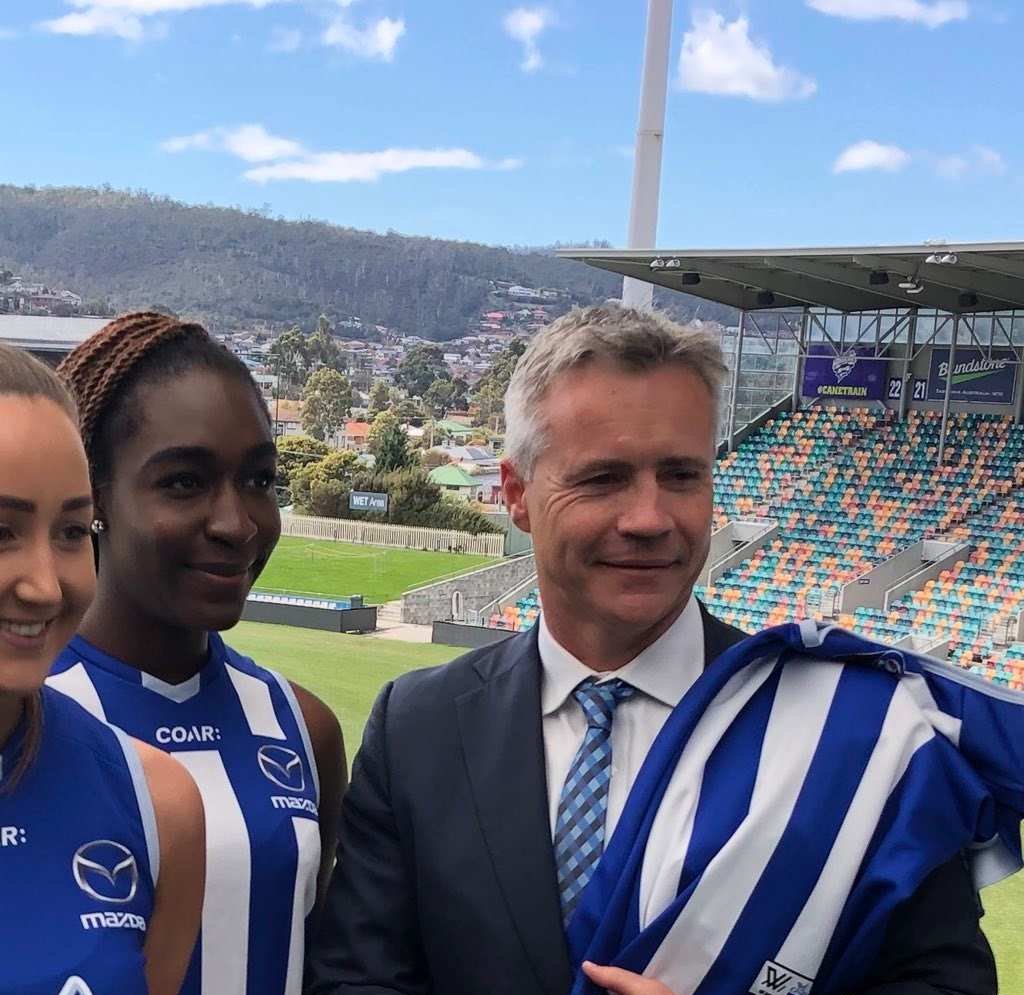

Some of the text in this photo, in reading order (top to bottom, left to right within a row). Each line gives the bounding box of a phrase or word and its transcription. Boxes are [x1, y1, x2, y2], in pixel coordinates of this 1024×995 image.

[938, 359, 1007, 377] Bundstone
[888, 379, 901, 397] 22
[914, 381, 925, 398] 21
[352, 495, 368, 506] WET
[80, 911, 146, 931] mazda
